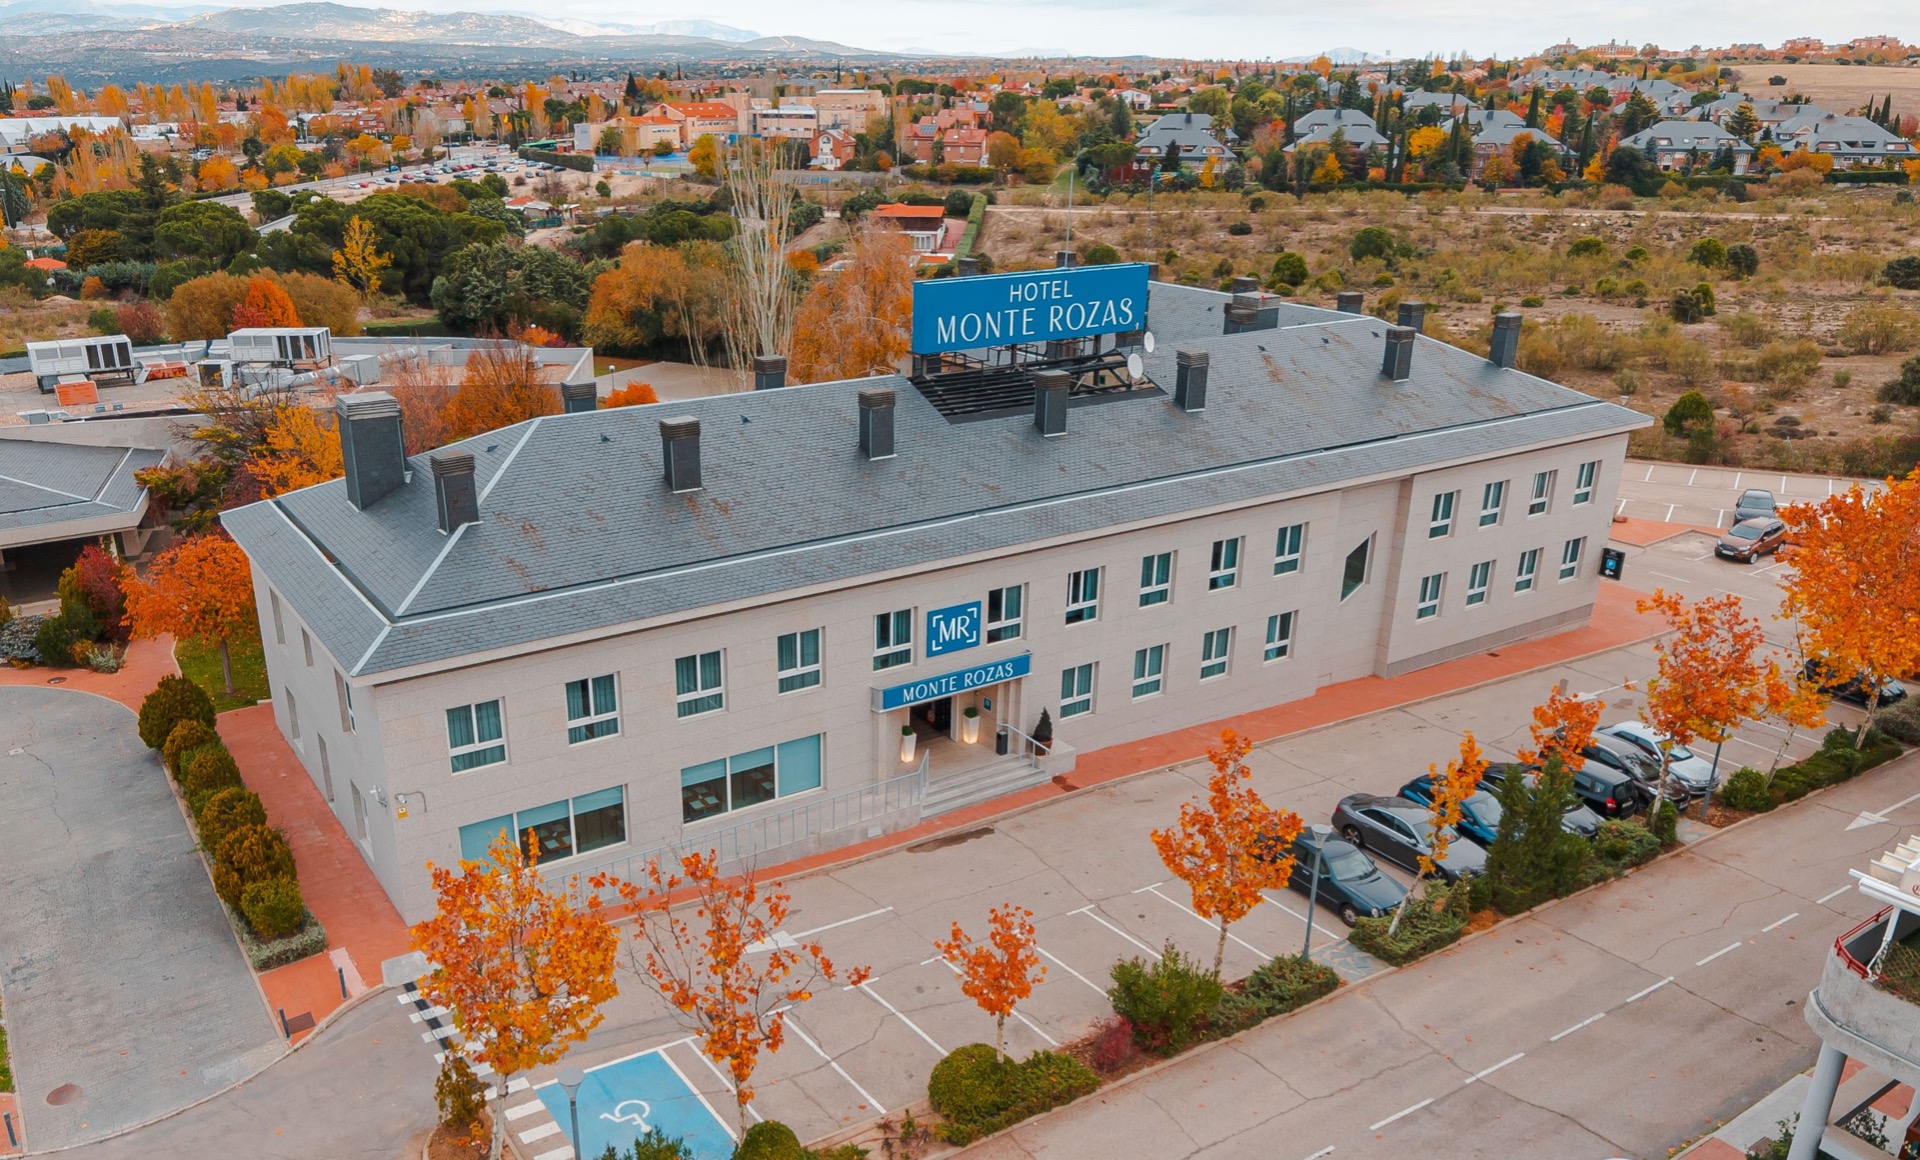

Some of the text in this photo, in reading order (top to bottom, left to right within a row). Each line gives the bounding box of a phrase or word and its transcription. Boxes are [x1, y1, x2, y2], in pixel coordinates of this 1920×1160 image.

[1009, 280, 1073, 303] HOTEL
[937, 298, 1133, 344] MONTE ROZAS
[939, 615, 970, 643] MR
[903, 662, 1014, 702] MONTE ROZAS
